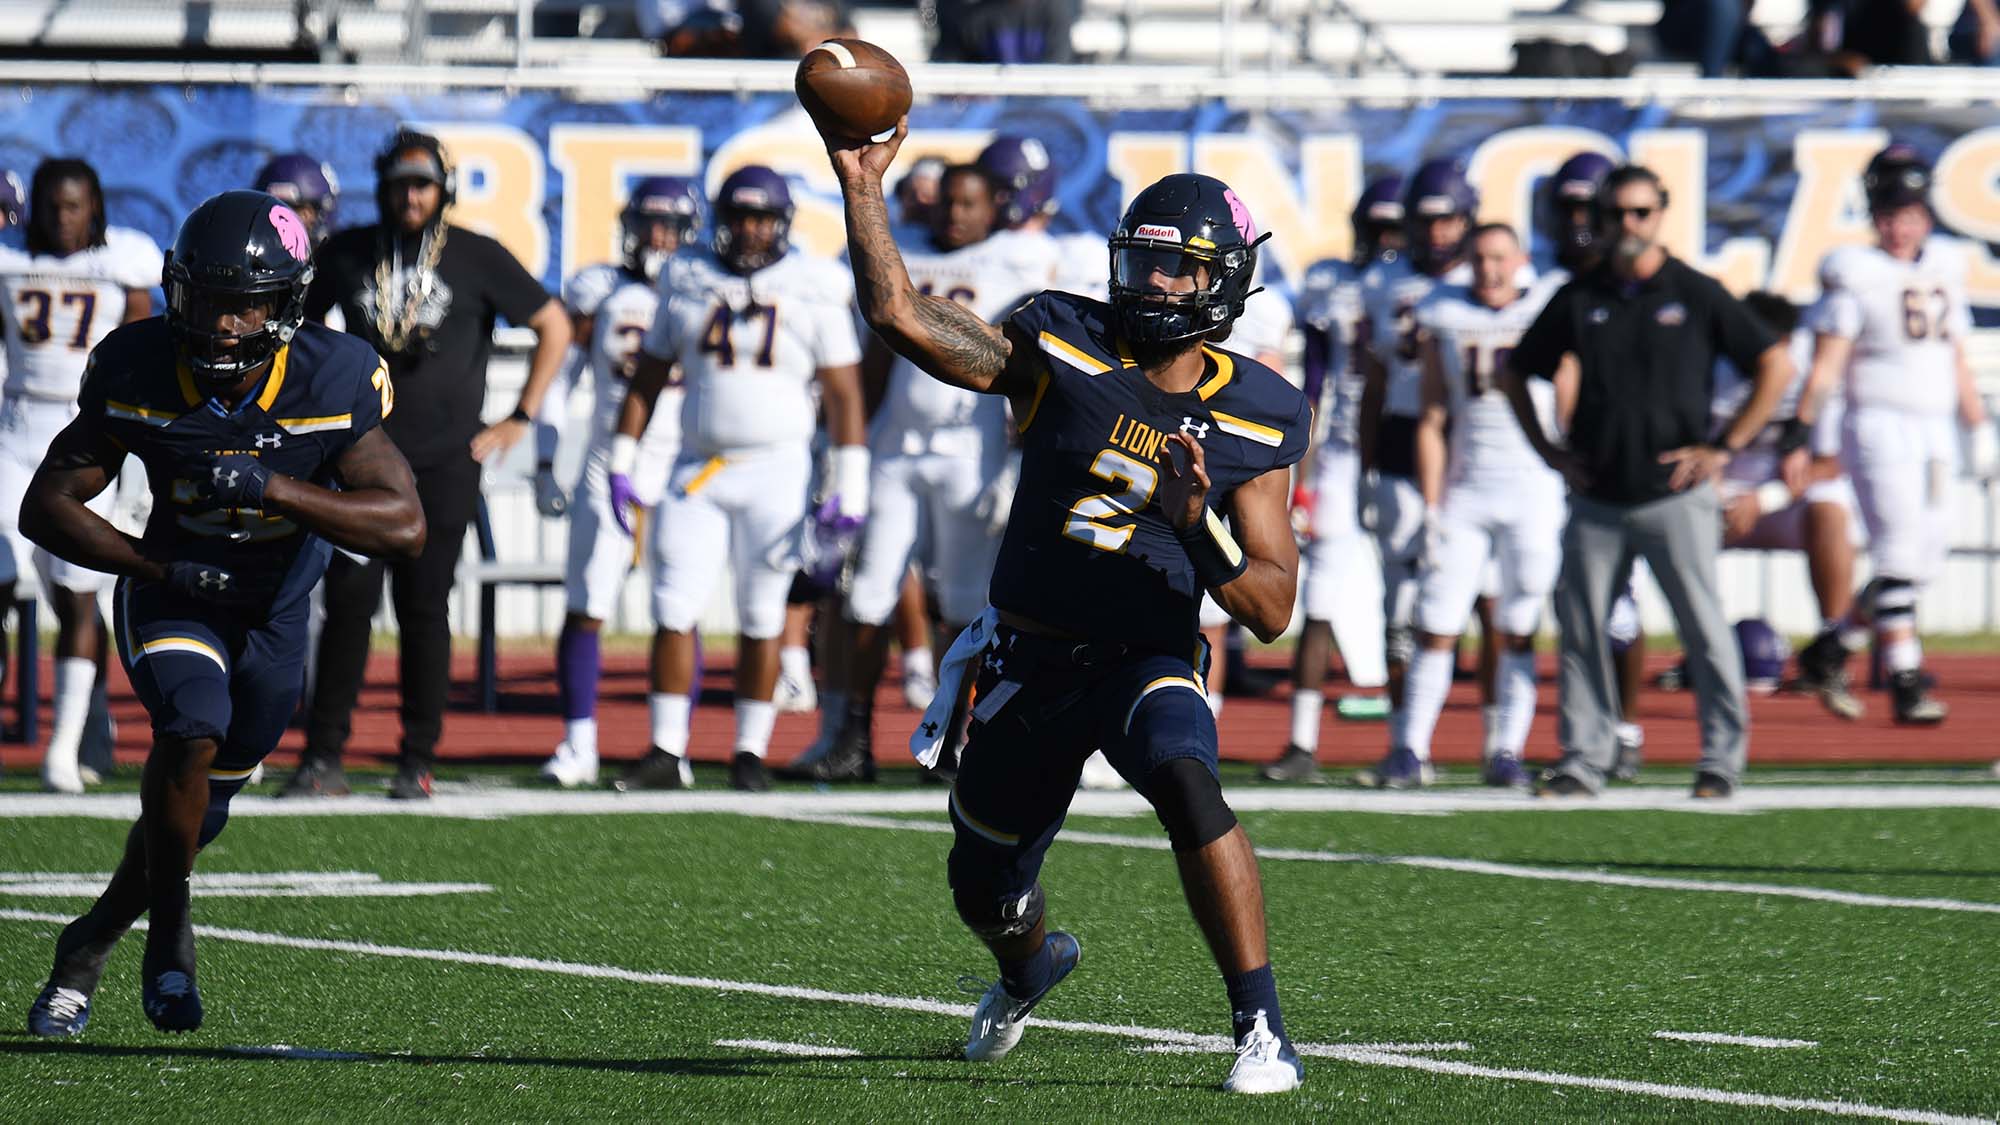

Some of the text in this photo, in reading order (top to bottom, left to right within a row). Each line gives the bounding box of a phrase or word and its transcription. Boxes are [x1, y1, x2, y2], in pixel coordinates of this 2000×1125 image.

[436, 112, 998, 290] BES
[1138, 227, 1175, 237] Riddell
[19, 288, 97, 351] 37
[699, 300, 777, 368] 47
[1062, 448, 1159, 556] 2
